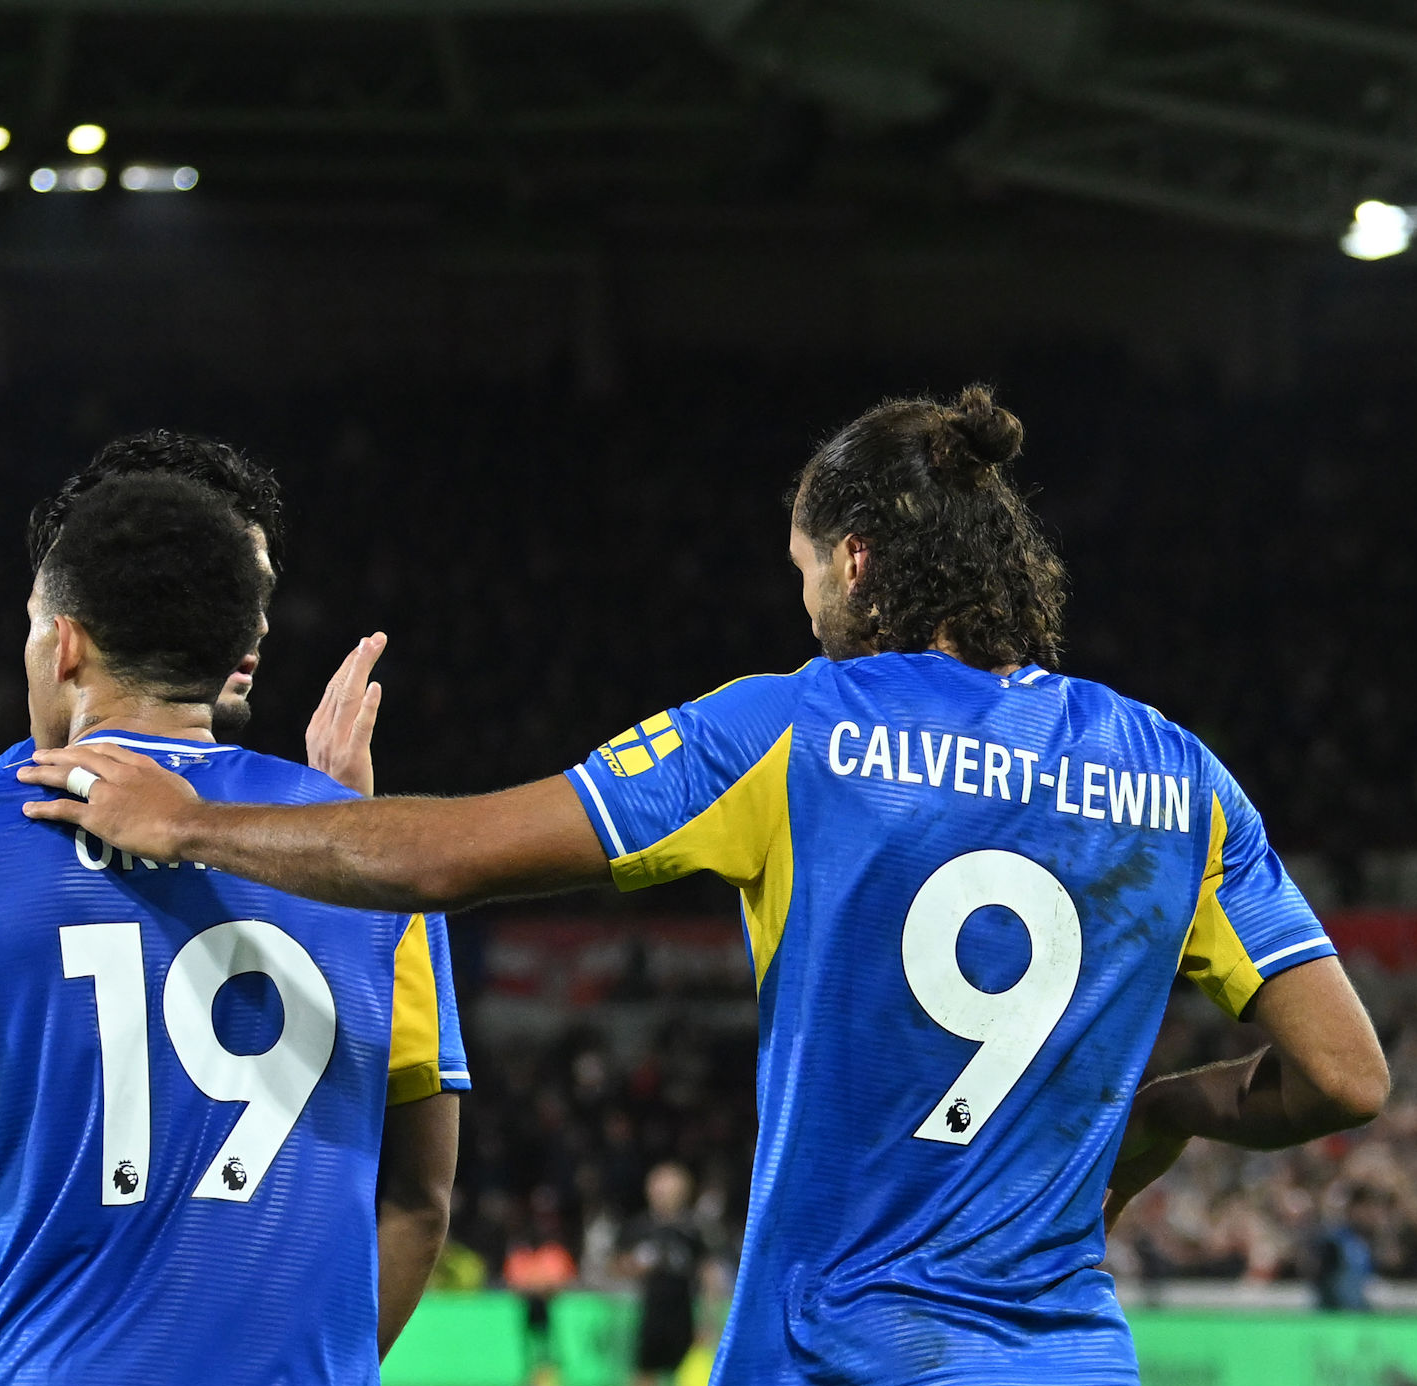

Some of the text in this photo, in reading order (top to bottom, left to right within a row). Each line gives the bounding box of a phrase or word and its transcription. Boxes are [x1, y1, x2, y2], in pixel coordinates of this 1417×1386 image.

[828, 720, 1191, 833] CALVERT-LEWIN
[58, 918, 337, 1206] 19
[901, 849, 1083, 1145] 9
